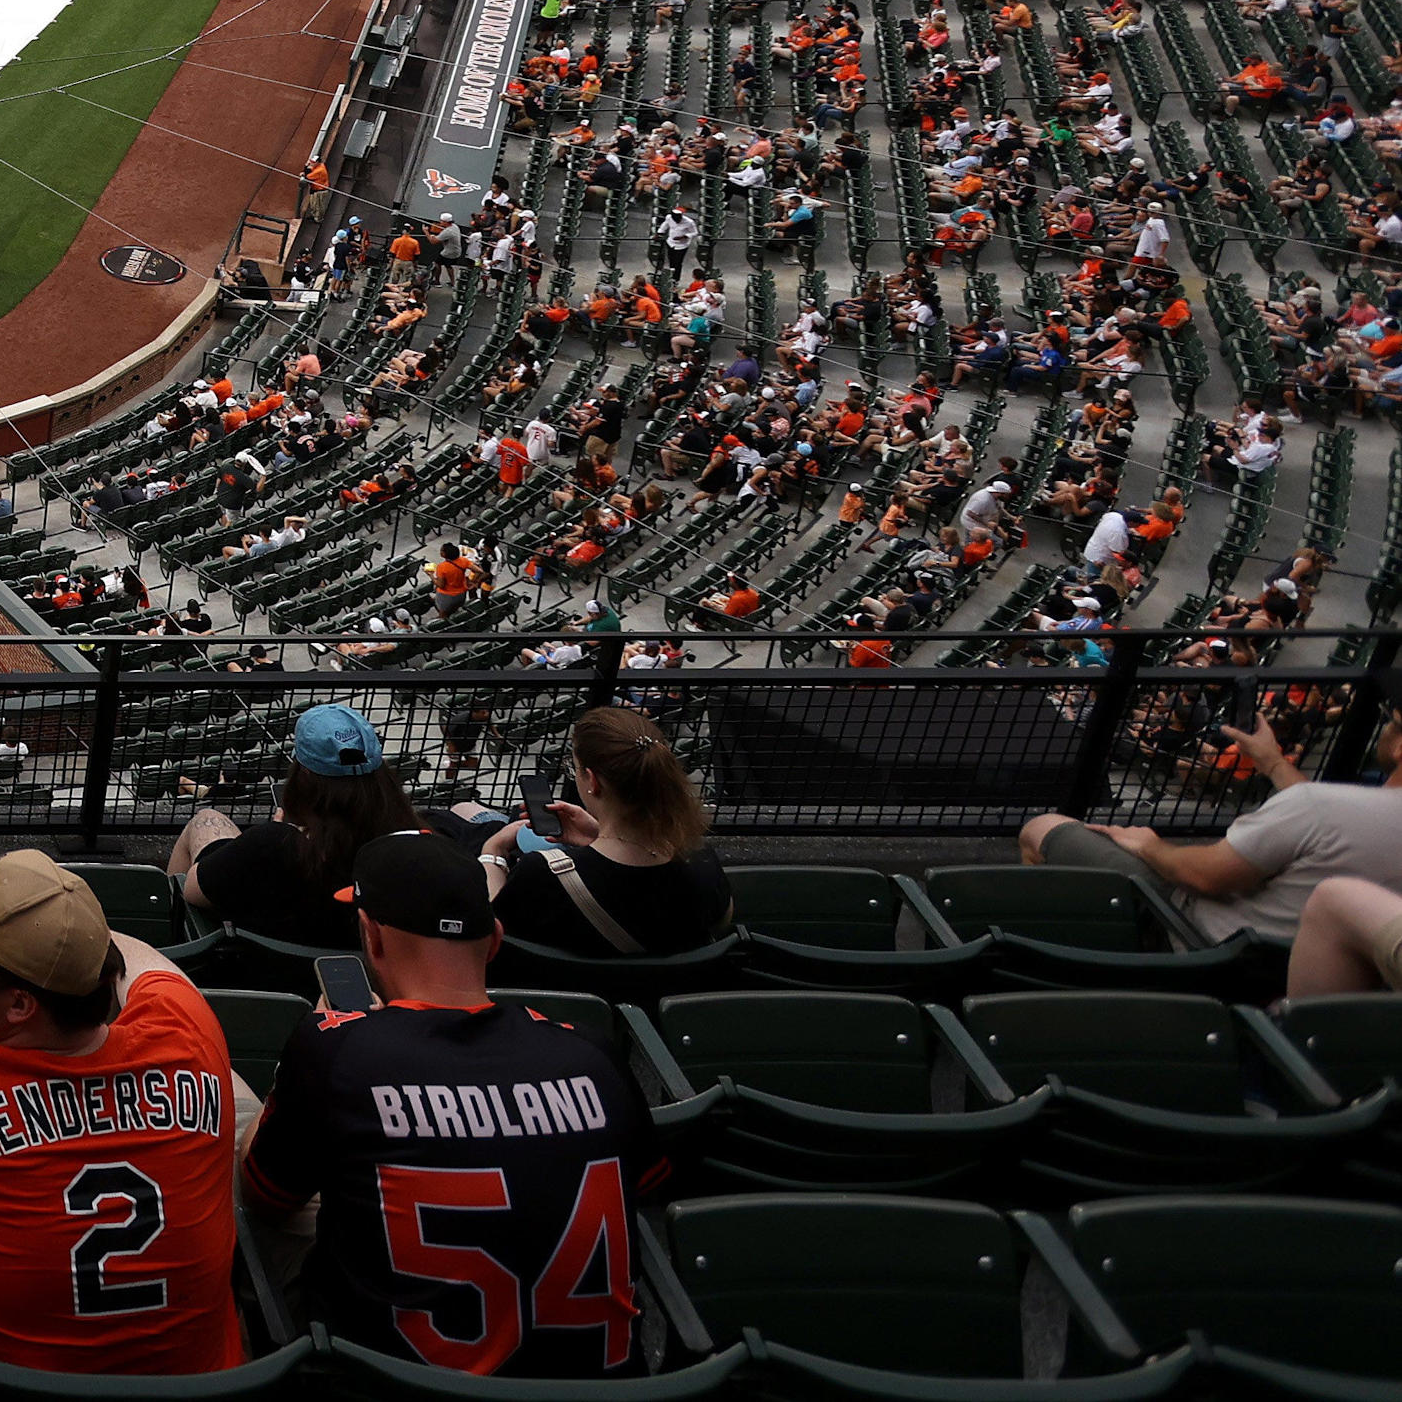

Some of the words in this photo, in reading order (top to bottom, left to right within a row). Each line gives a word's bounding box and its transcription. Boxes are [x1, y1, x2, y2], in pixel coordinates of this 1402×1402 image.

[450, 83, 495, 129] HOME
[370, 1075, 607, 1138] BIRDLAND
[63, 1160, 167, 1317] 2
[376, 1156, 640, 1378] 54
